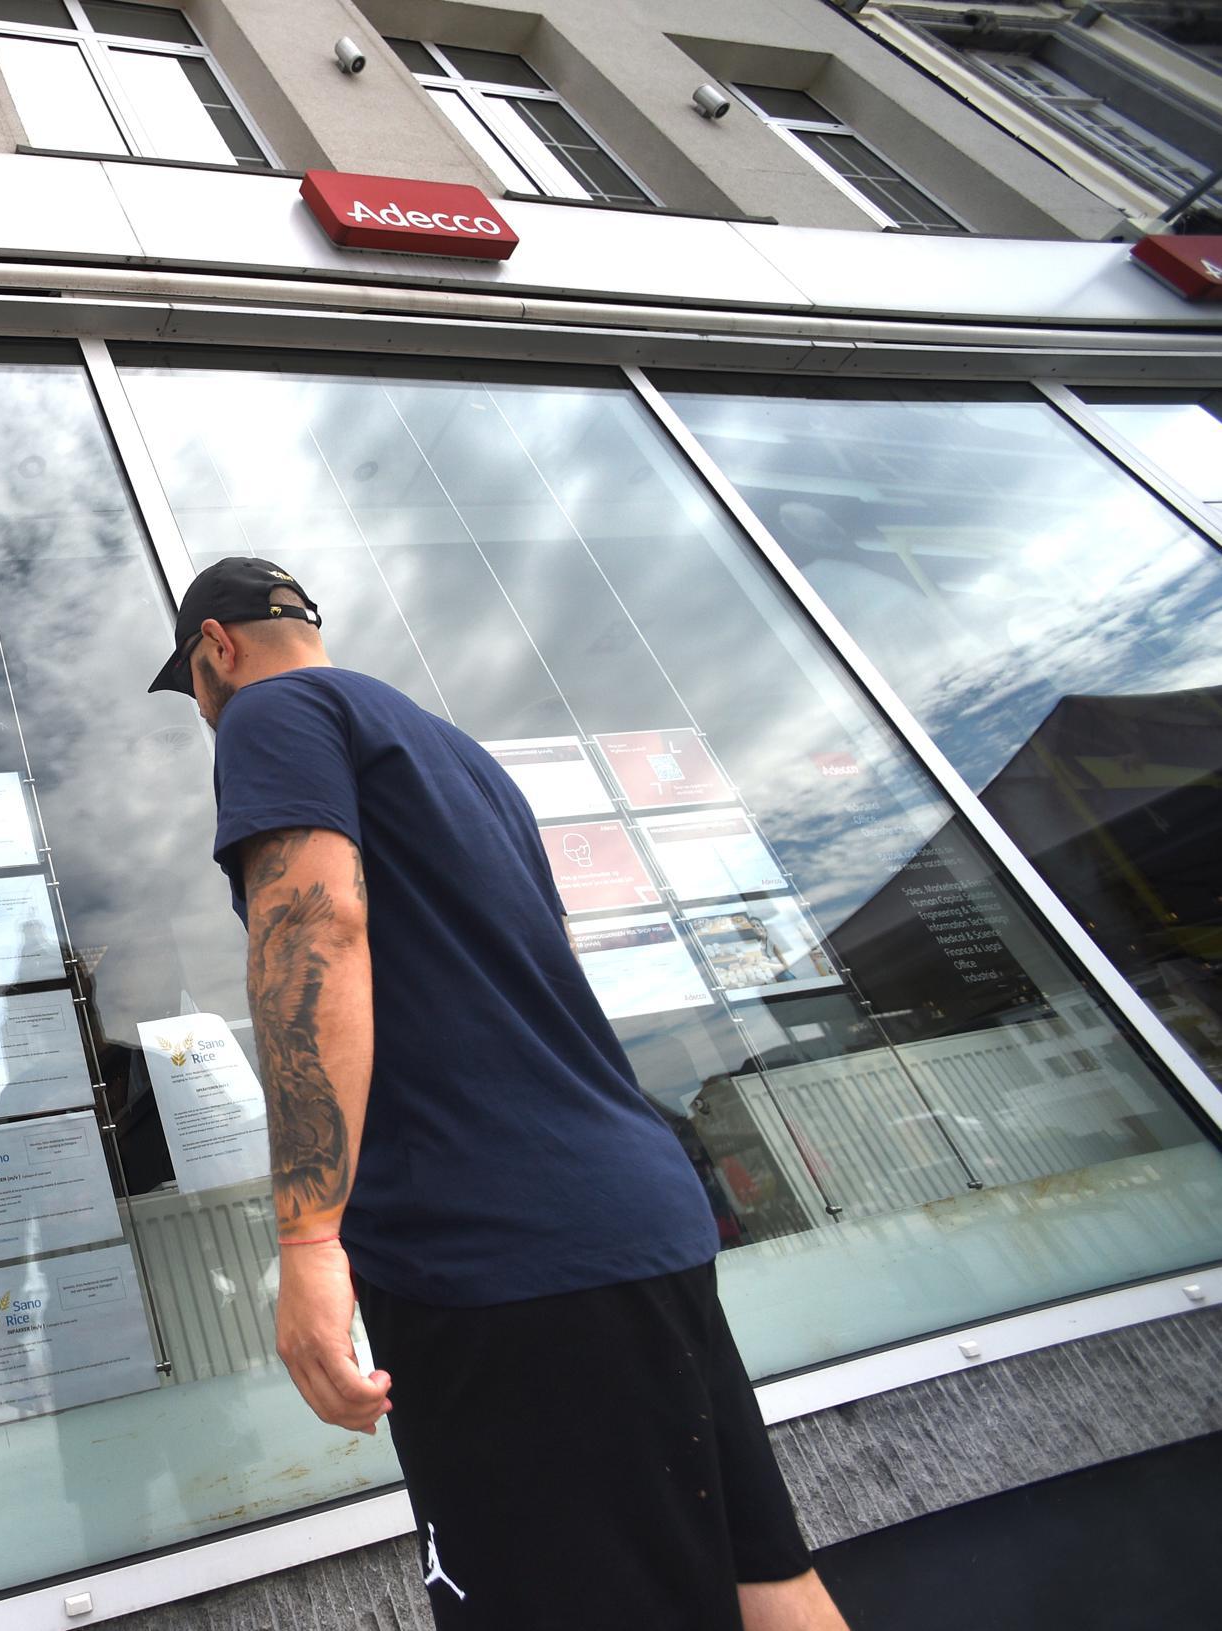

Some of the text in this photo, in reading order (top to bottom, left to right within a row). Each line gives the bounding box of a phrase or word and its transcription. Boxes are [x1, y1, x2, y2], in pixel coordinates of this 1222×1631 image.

[347, 200, 501, 235] Adecco
[901, 886, 925, 897] Sales,
[909, 897, 938, 908] Human
[938, 893, 962, 904] Capital
[918, 907, 963, 921] Engineering
[926, 920, 969, 932] Information
[936, 932, 966, 945] Medical
[973, 928, 1003, 940] Science
[944, 946, 975, 958] Finance
[981, 942, 1003, 954] Legal
[953, 959, 978, 970] Office
[197, 1037, 225, 1051] Sano
[191, 1051, 216, 1065] Rice
[12, 1298, 42, 1313] Sano
[6, 1313, 30, 1327] Rice
